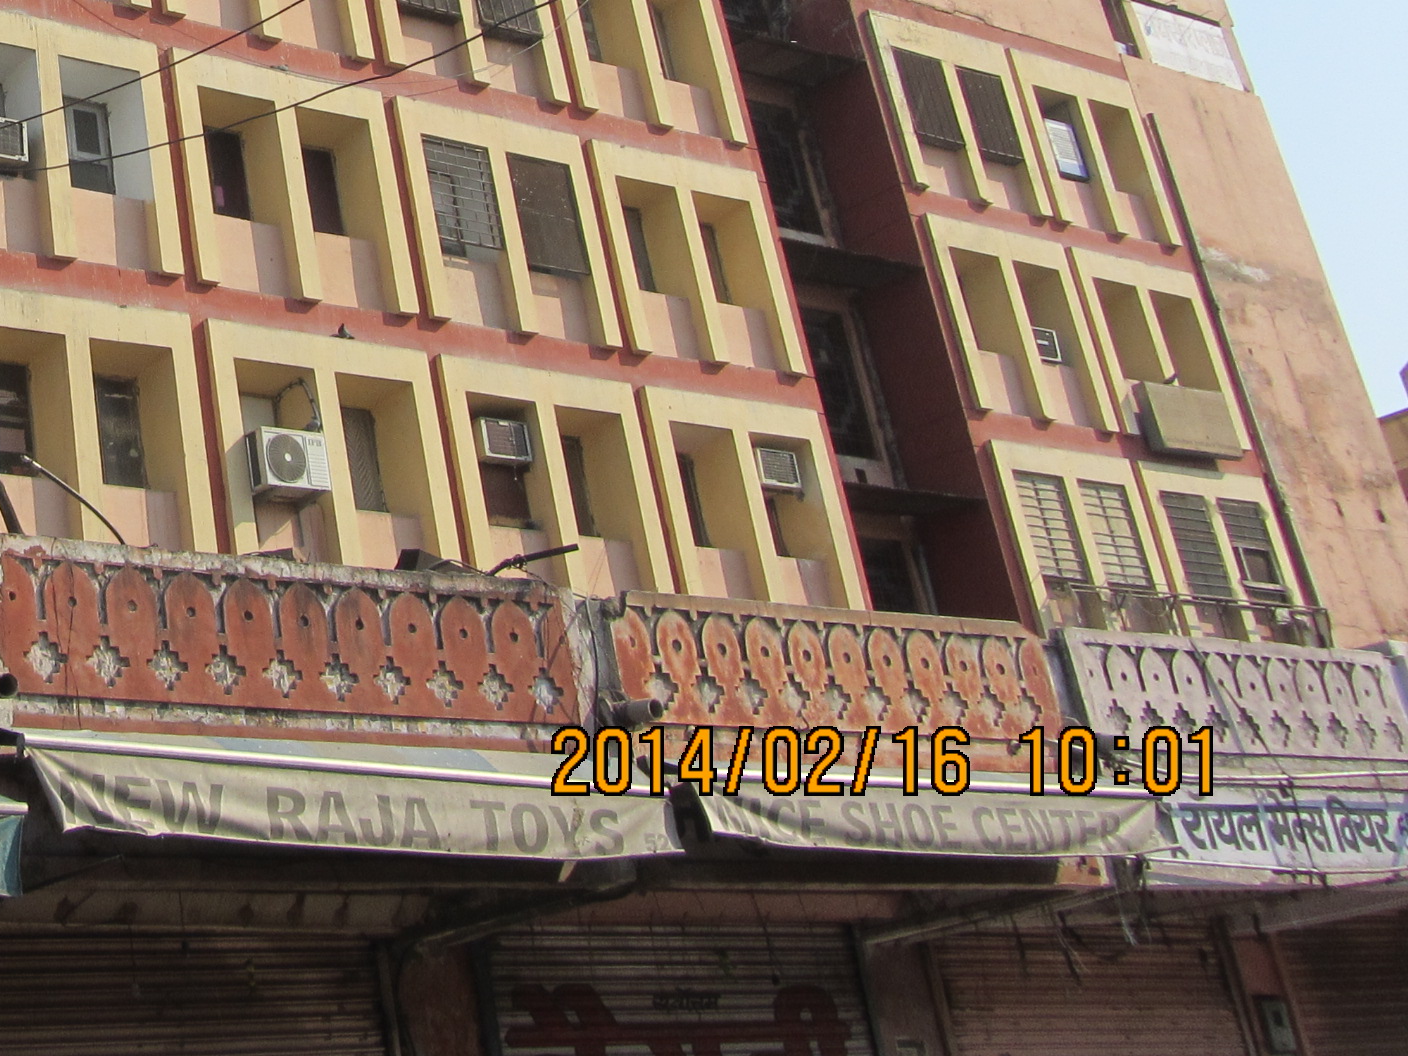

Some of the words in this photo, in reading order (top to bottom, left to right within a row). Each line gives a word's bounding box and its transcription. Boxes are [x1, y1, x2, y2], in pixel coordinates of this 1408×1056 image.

[59, 770, 225, 834] NEW
[265, 786, 443, 853] RAJA
[469, 798, 626, 856] TOYS
[842, 800, 964, 850] SHOE
[972, 801, 1131, 852] CENTER
